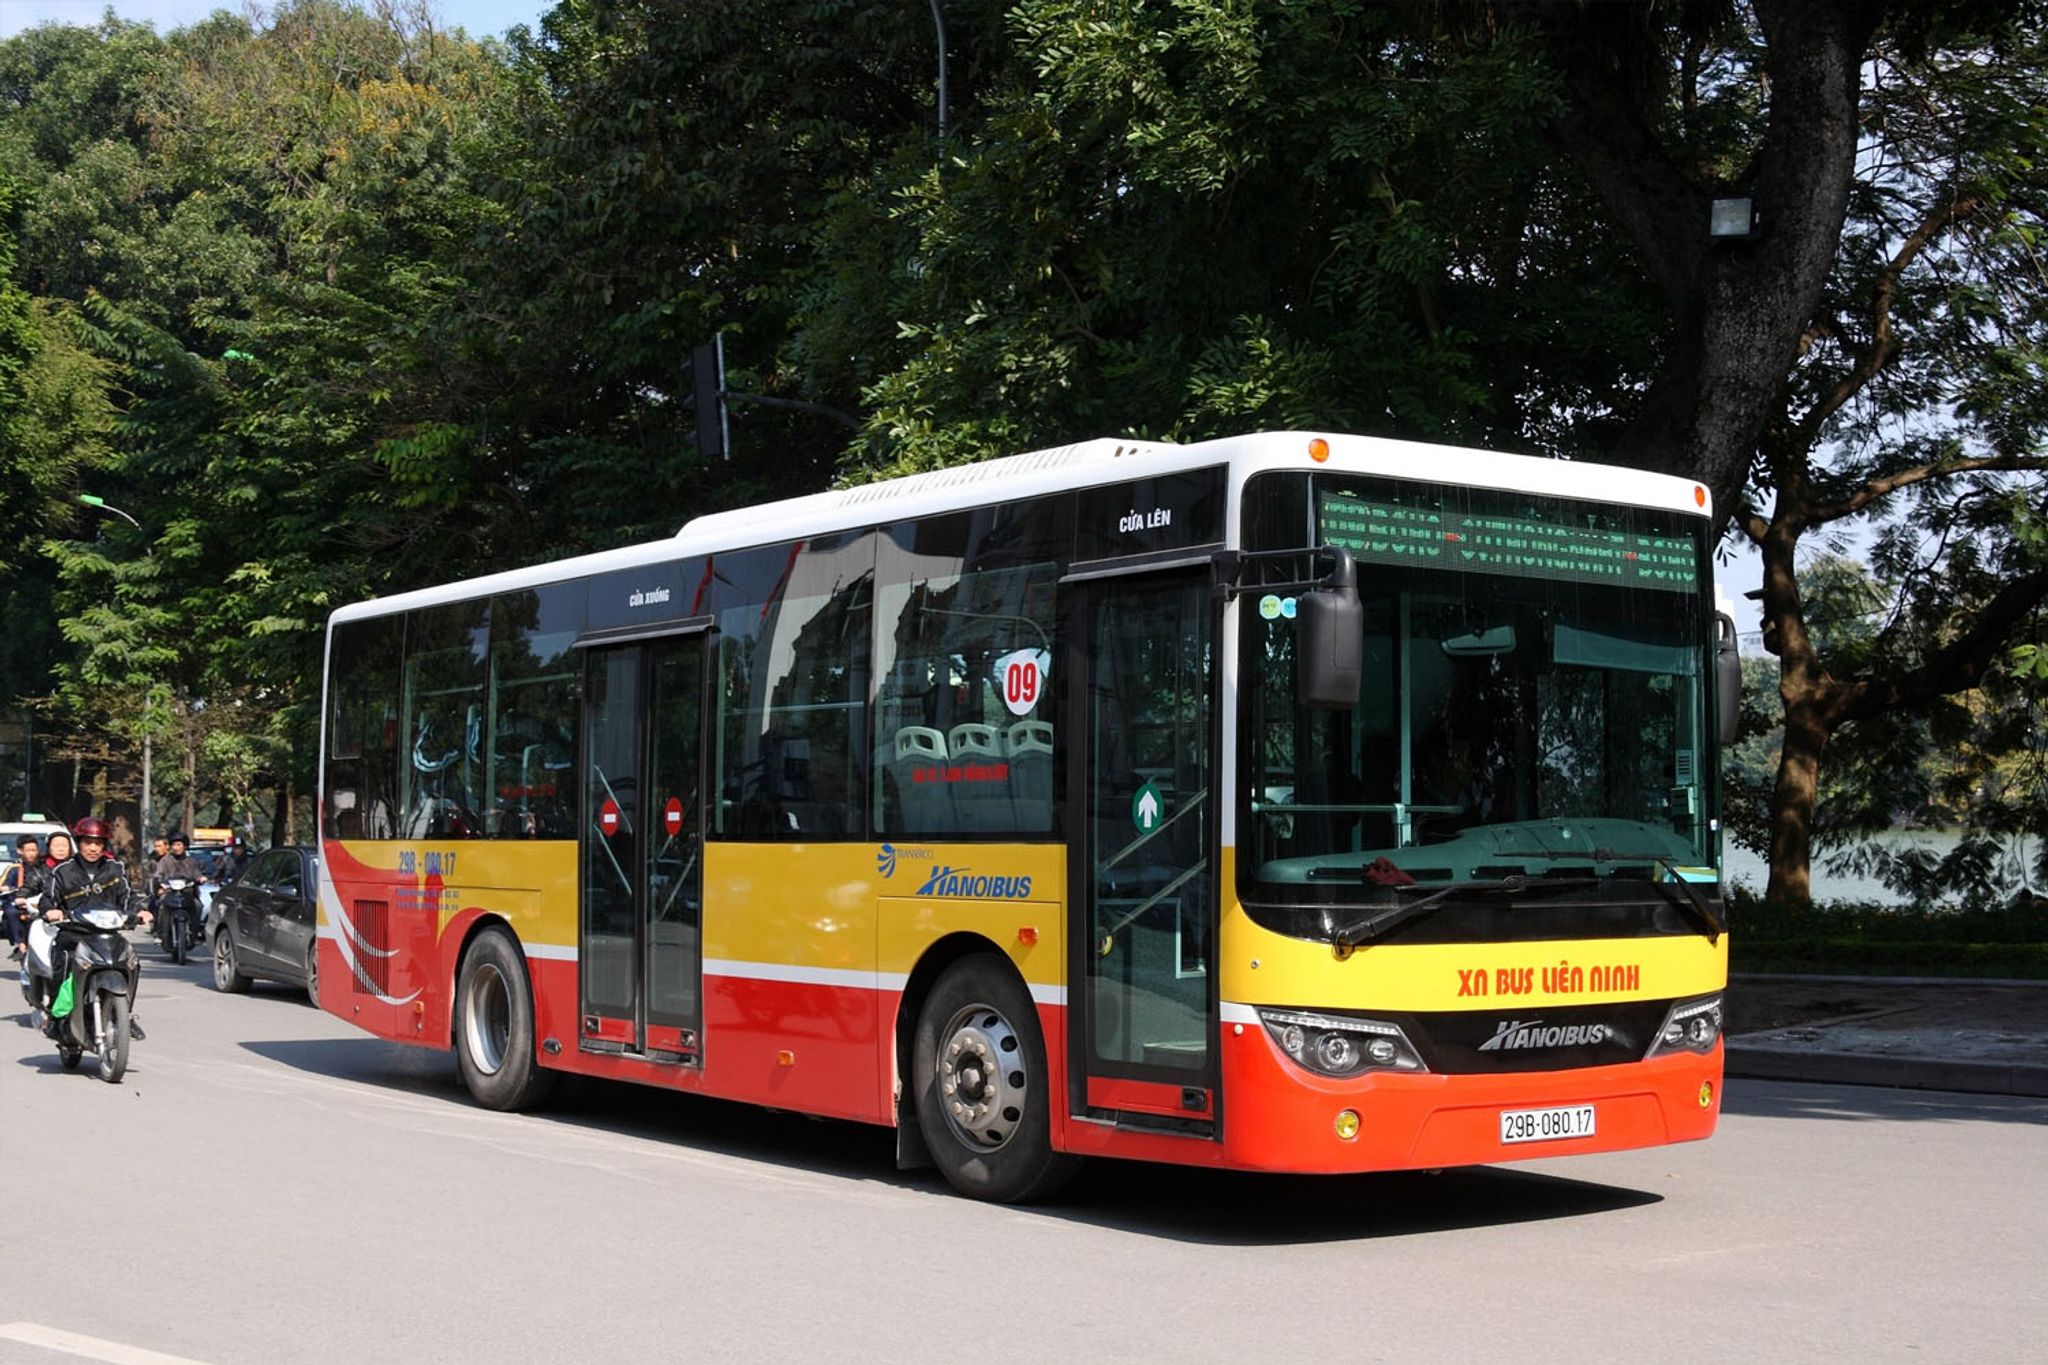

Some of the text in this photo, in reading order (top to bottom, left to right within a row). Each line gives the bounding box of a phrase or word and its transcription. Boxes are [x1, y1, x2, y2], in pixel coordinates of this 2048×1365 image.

[1119, 507, 1171, 533] CỬA LÊN
[1007, 662, 1037, 703] 09
[915, 865, 1032, 898] HANOIBUS
[1457, 960, 1640, 997] XN BUS LIÊN NINH
[1478, 1020, 1606, 1051] HANOIBUS
[1504, 1109, 1592, 1140] 29B-080.17
